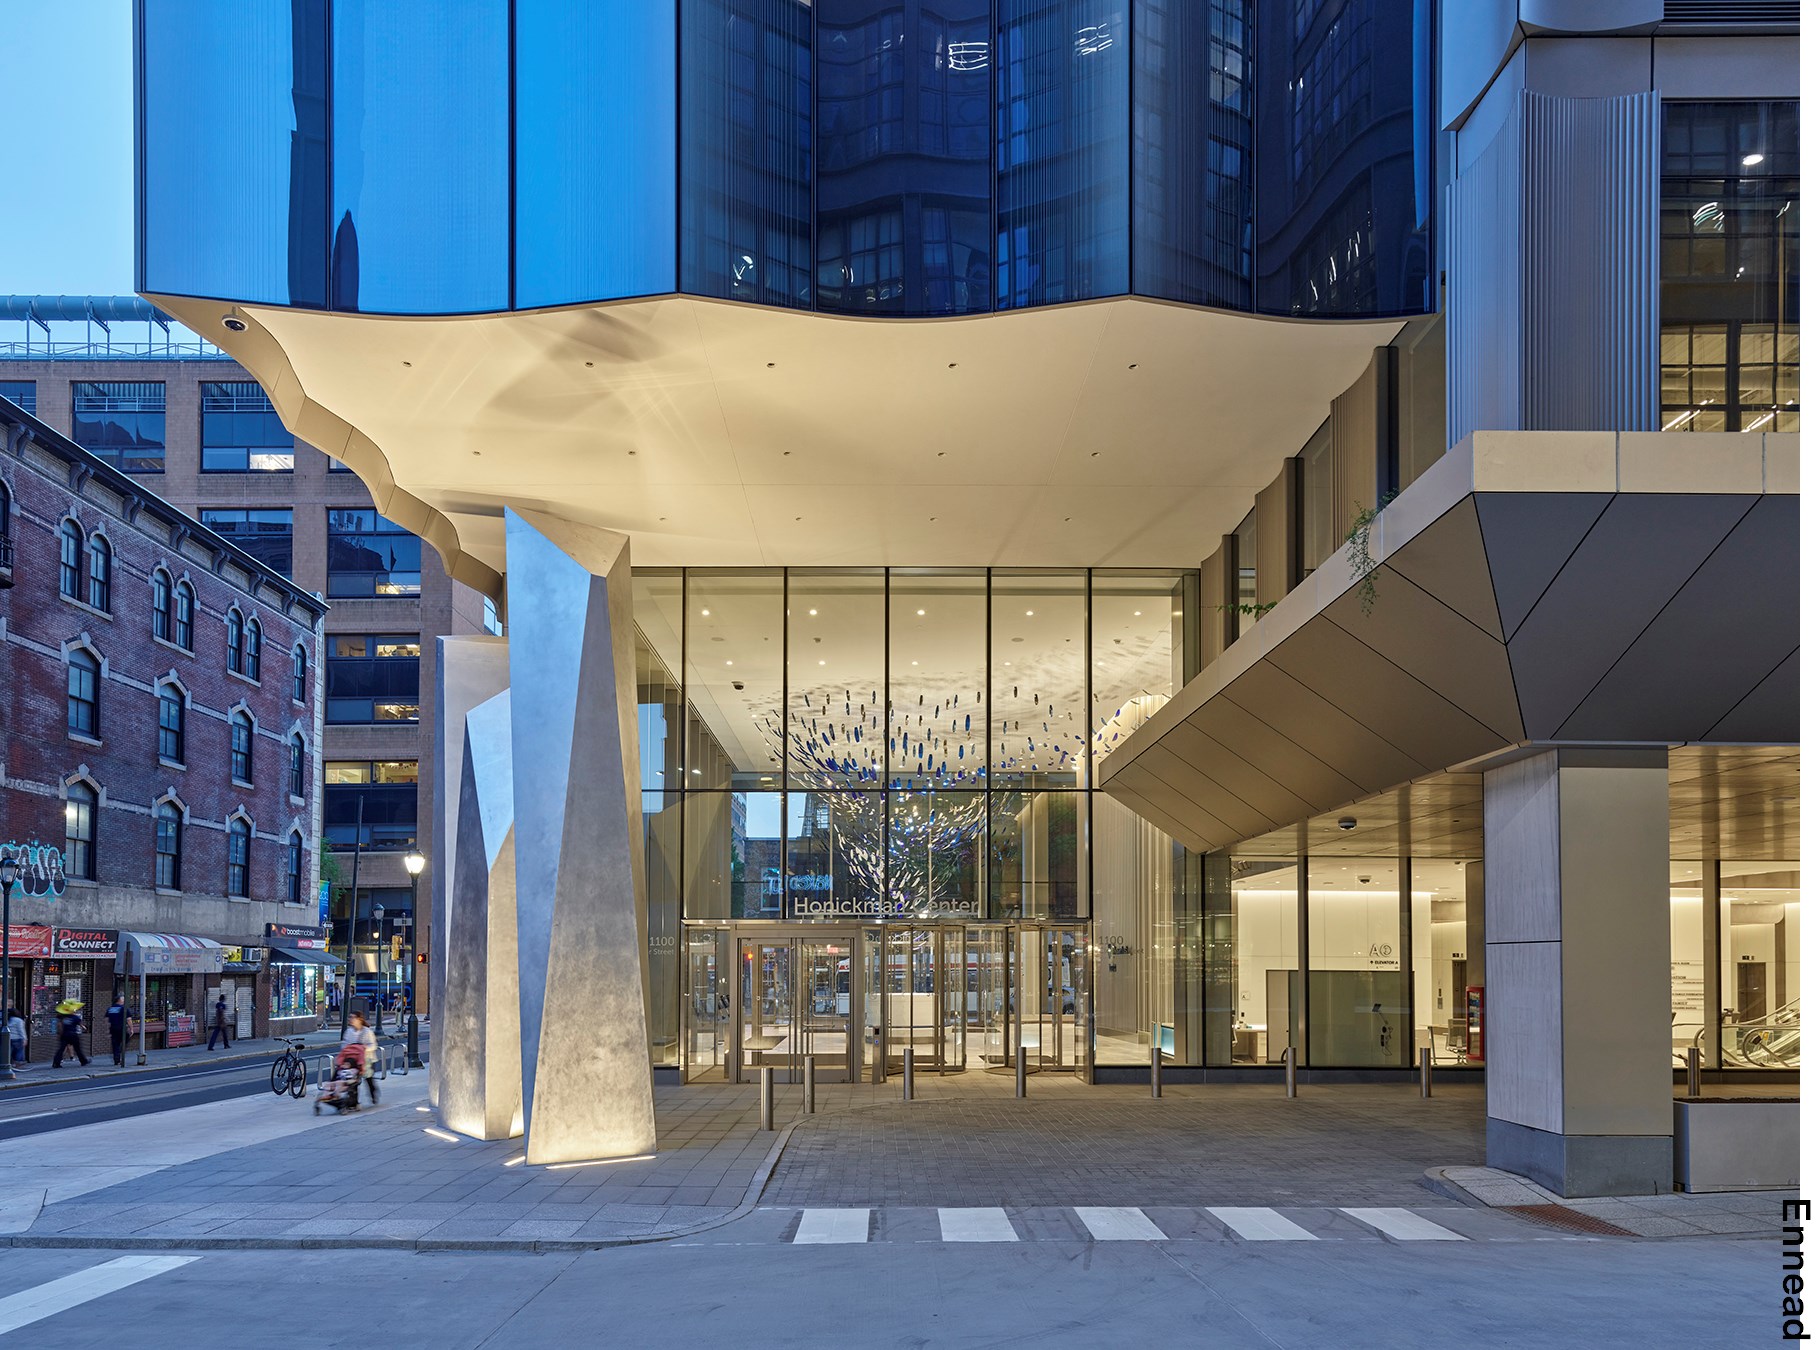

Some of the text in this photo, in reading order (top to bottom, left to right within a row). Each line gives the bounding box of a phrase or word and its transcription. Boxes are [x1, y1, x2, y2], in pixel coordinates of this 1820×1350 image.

[794, 897, 979, 914] Honickman Center
[58, 929, 108, 940] DIGITAL
[59, 938, 115, 949] CONNECT
[649, 936, 675, 946] 1100
